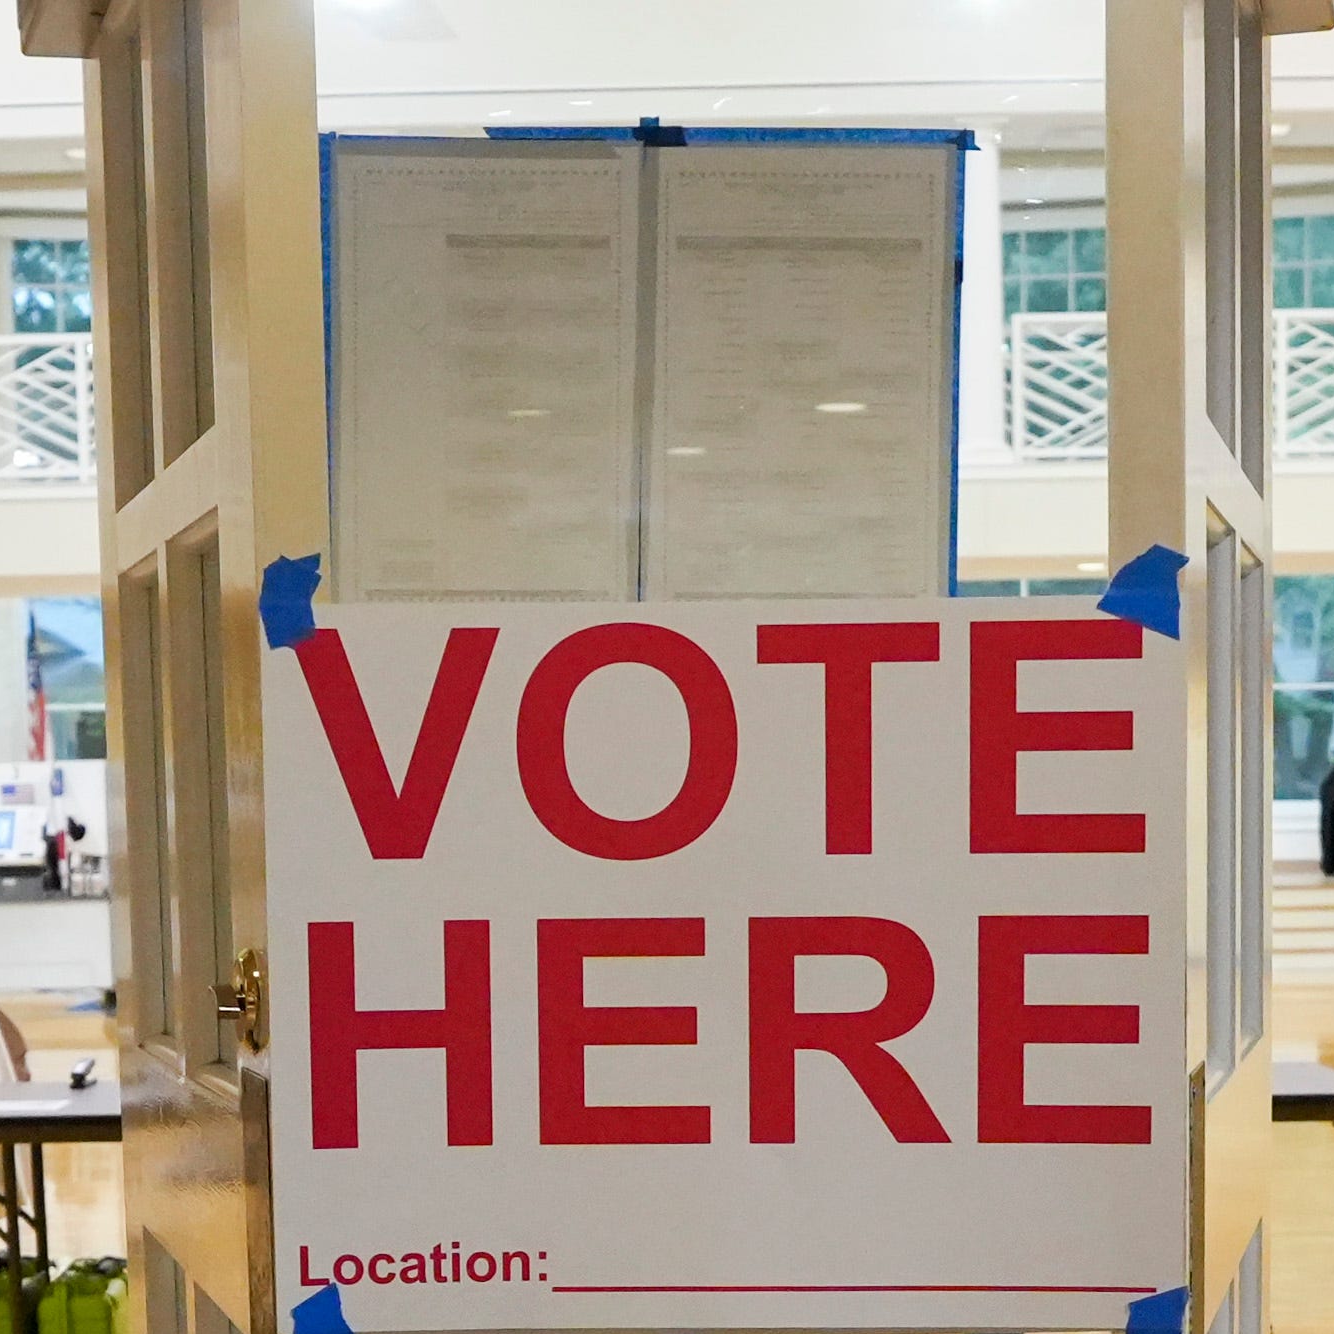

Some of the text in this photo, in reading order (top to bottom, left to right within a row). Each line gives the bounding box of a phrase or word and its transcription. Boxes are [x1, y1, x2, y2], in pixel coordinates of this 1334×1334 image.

[293, 619, 1146, 861] VOTE
[307, 914, 1153, 1150] HERE
[298, 1242, 549, 1287] Location:
